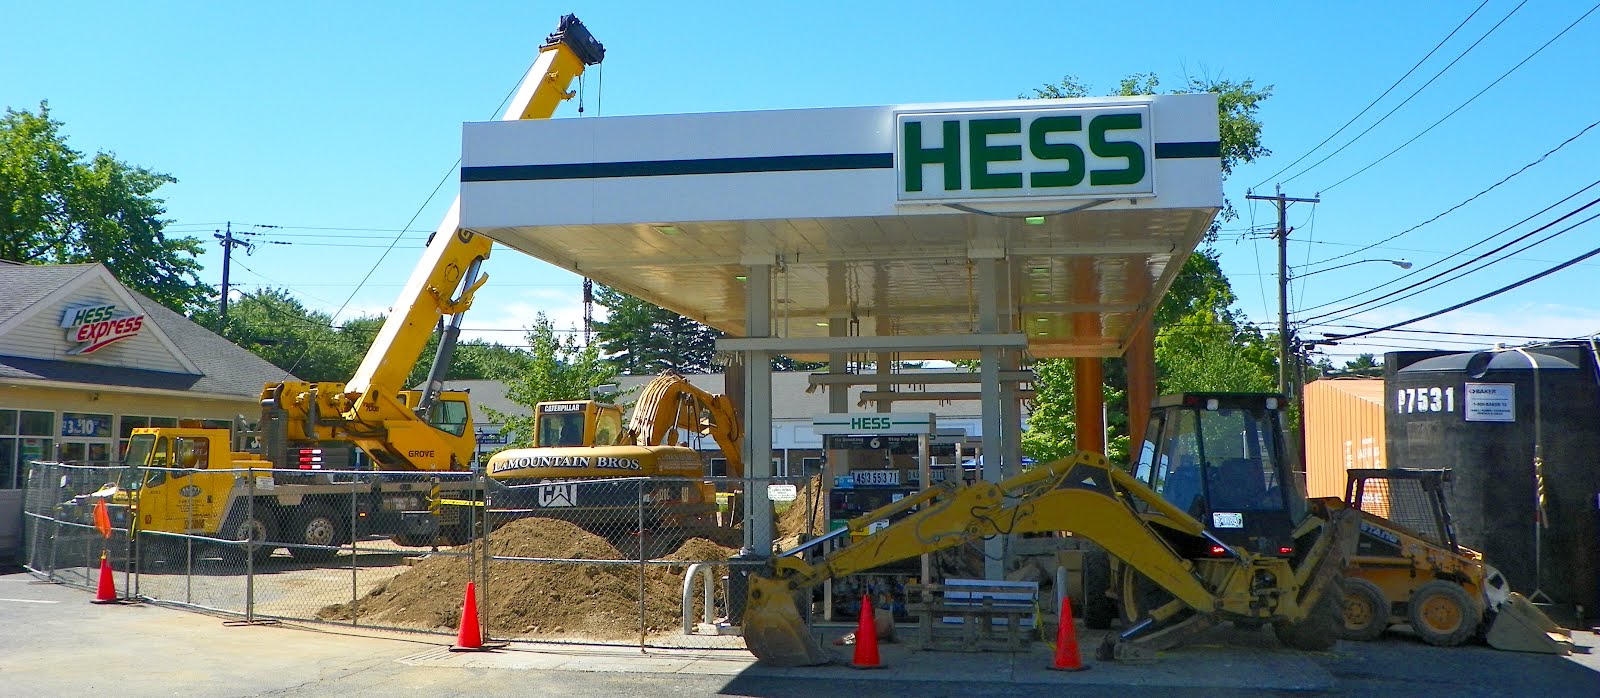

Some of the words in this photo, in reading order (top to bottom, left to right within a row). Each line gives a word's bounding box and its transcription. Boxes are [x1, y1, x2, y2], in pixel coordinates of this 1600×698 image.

[904, 113, 1146, 193] HESS
[72, 305, 116, 327] HESS
[544, 403, 580, 413] CATERPILLAR
[1398, 386, 1454, 414] P7531
[851, 417, 891, 430] HESS
[869, 437, 881, 449] 6
[408, 450, 435, 458] GROVE
[493, 456, 590, 474] LAMOUNTAIN
[596, 456, 643, 471] BROS.
[538, 479, 579, 508] CAT
